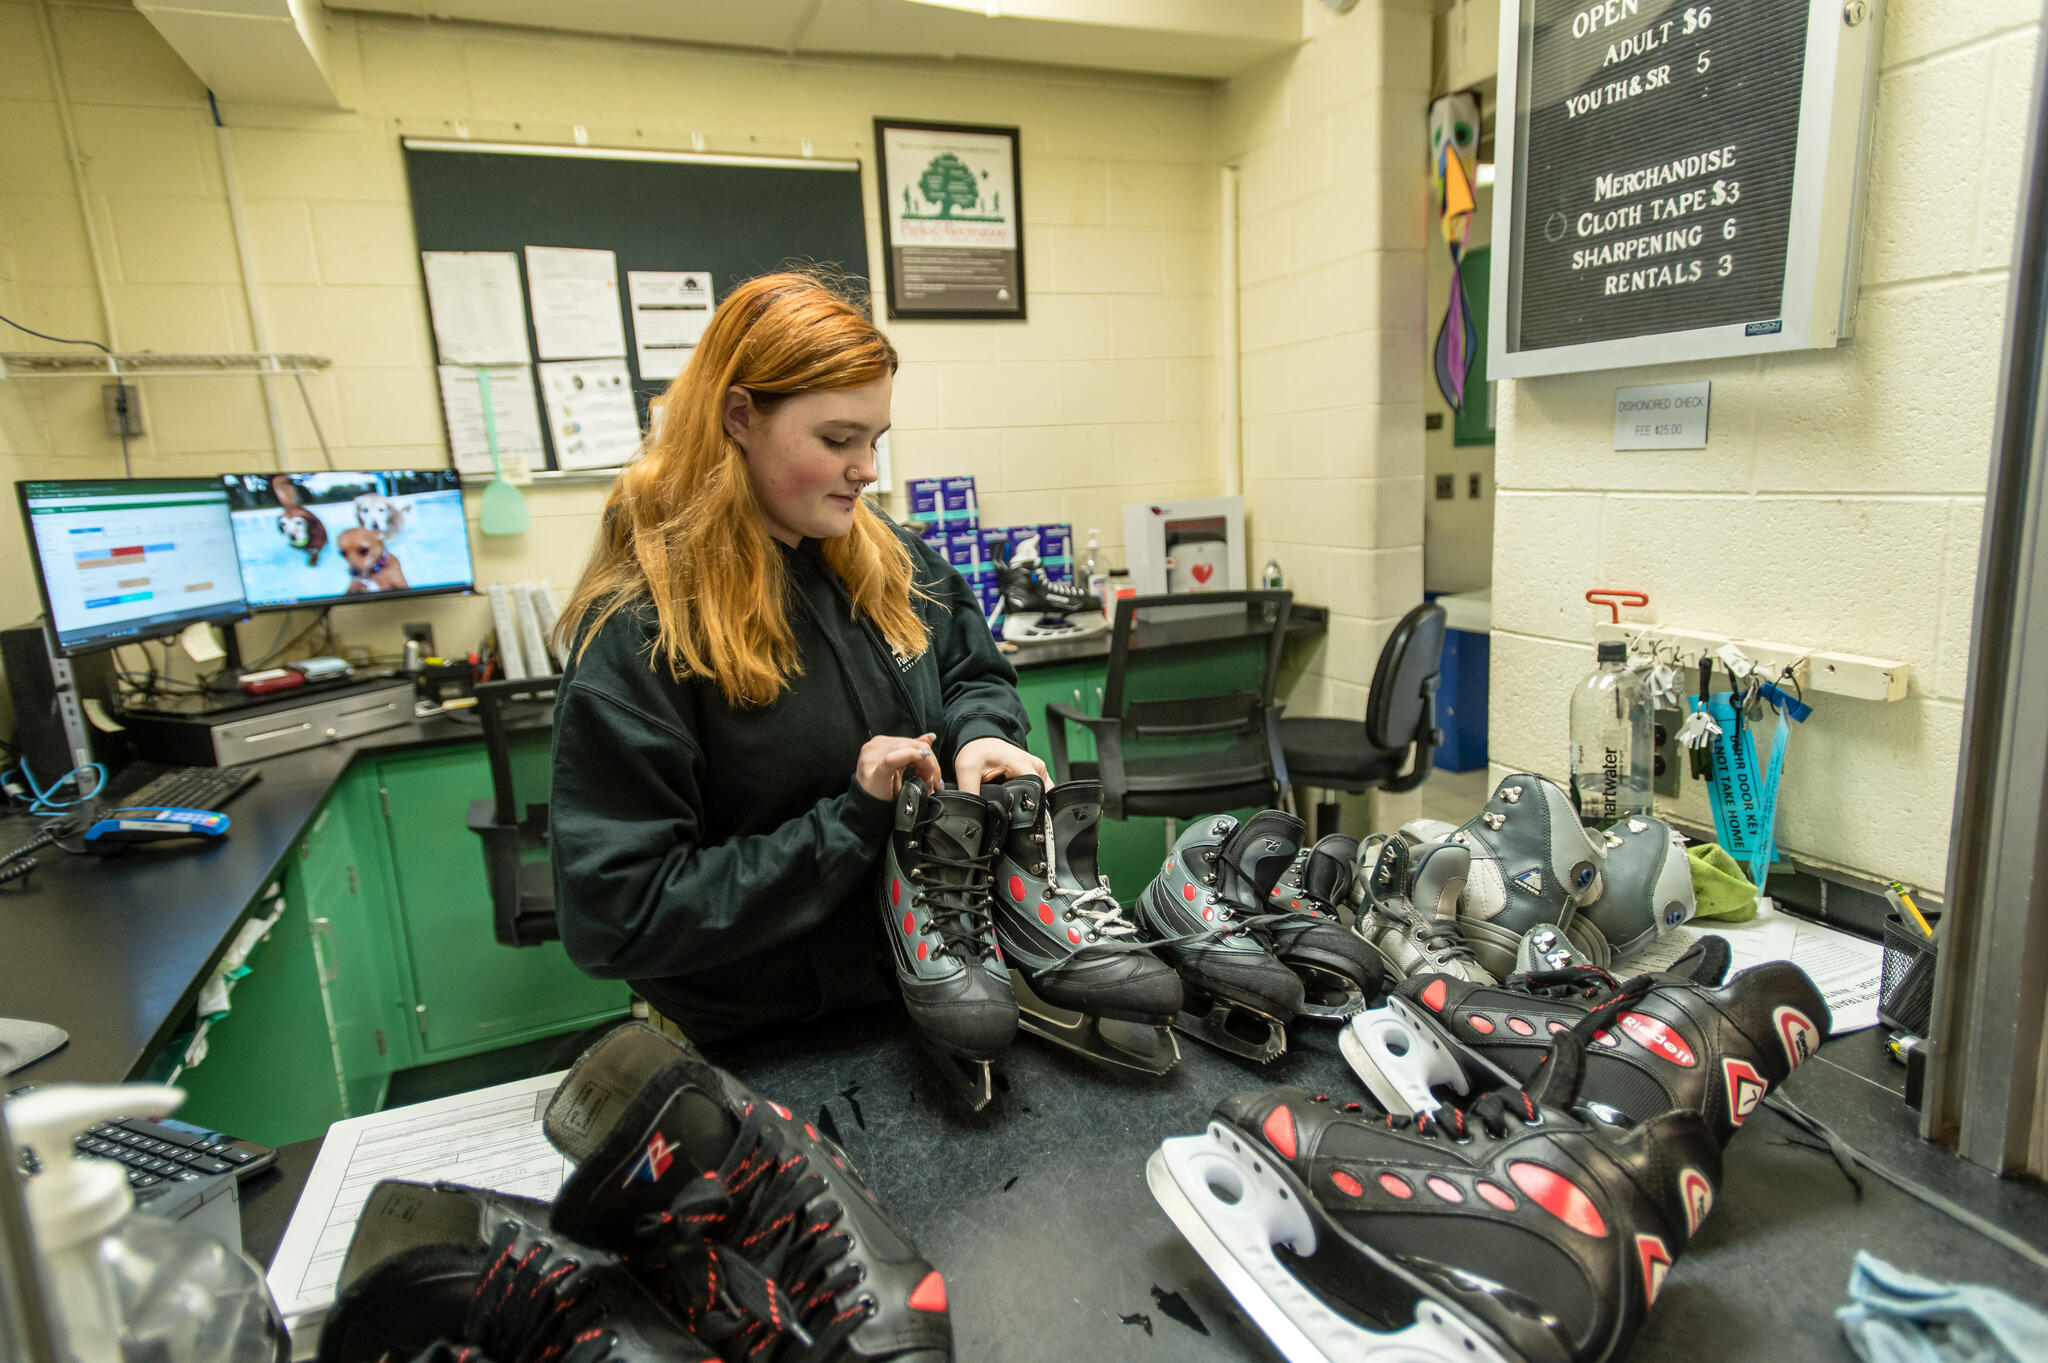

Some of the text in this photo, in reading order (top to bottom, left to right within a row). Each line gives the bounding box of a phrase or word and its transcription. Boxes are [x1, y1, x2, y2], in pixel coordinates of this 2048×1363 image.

[1572, 0, 1639, 38] OPEN
[1603, 6, 1712, 67] ADULT $6
[1696, 50, 1711, 73] 5
[1594, 145, 1737, 202] MERCHANDISE
[1577, 179, 1741, 237] CLOTH TAPE $3
[1572, 218, 1737, 270] SHARPENING 6
[1604, 255, 1733, 295] RENTALS 3
[1674, 396, 1704, 409] CHECK
[1635, 423, 1683, 436] FEE $25.00
[1715, 746, 1729, 773] NOT
[1720, 775, 1736, 807] TAKE
[1738, 774, 1755, 811] DOOR
[1727, 810, 1745, 848] HOME
[1745, 813, 1758, 836] KEY
